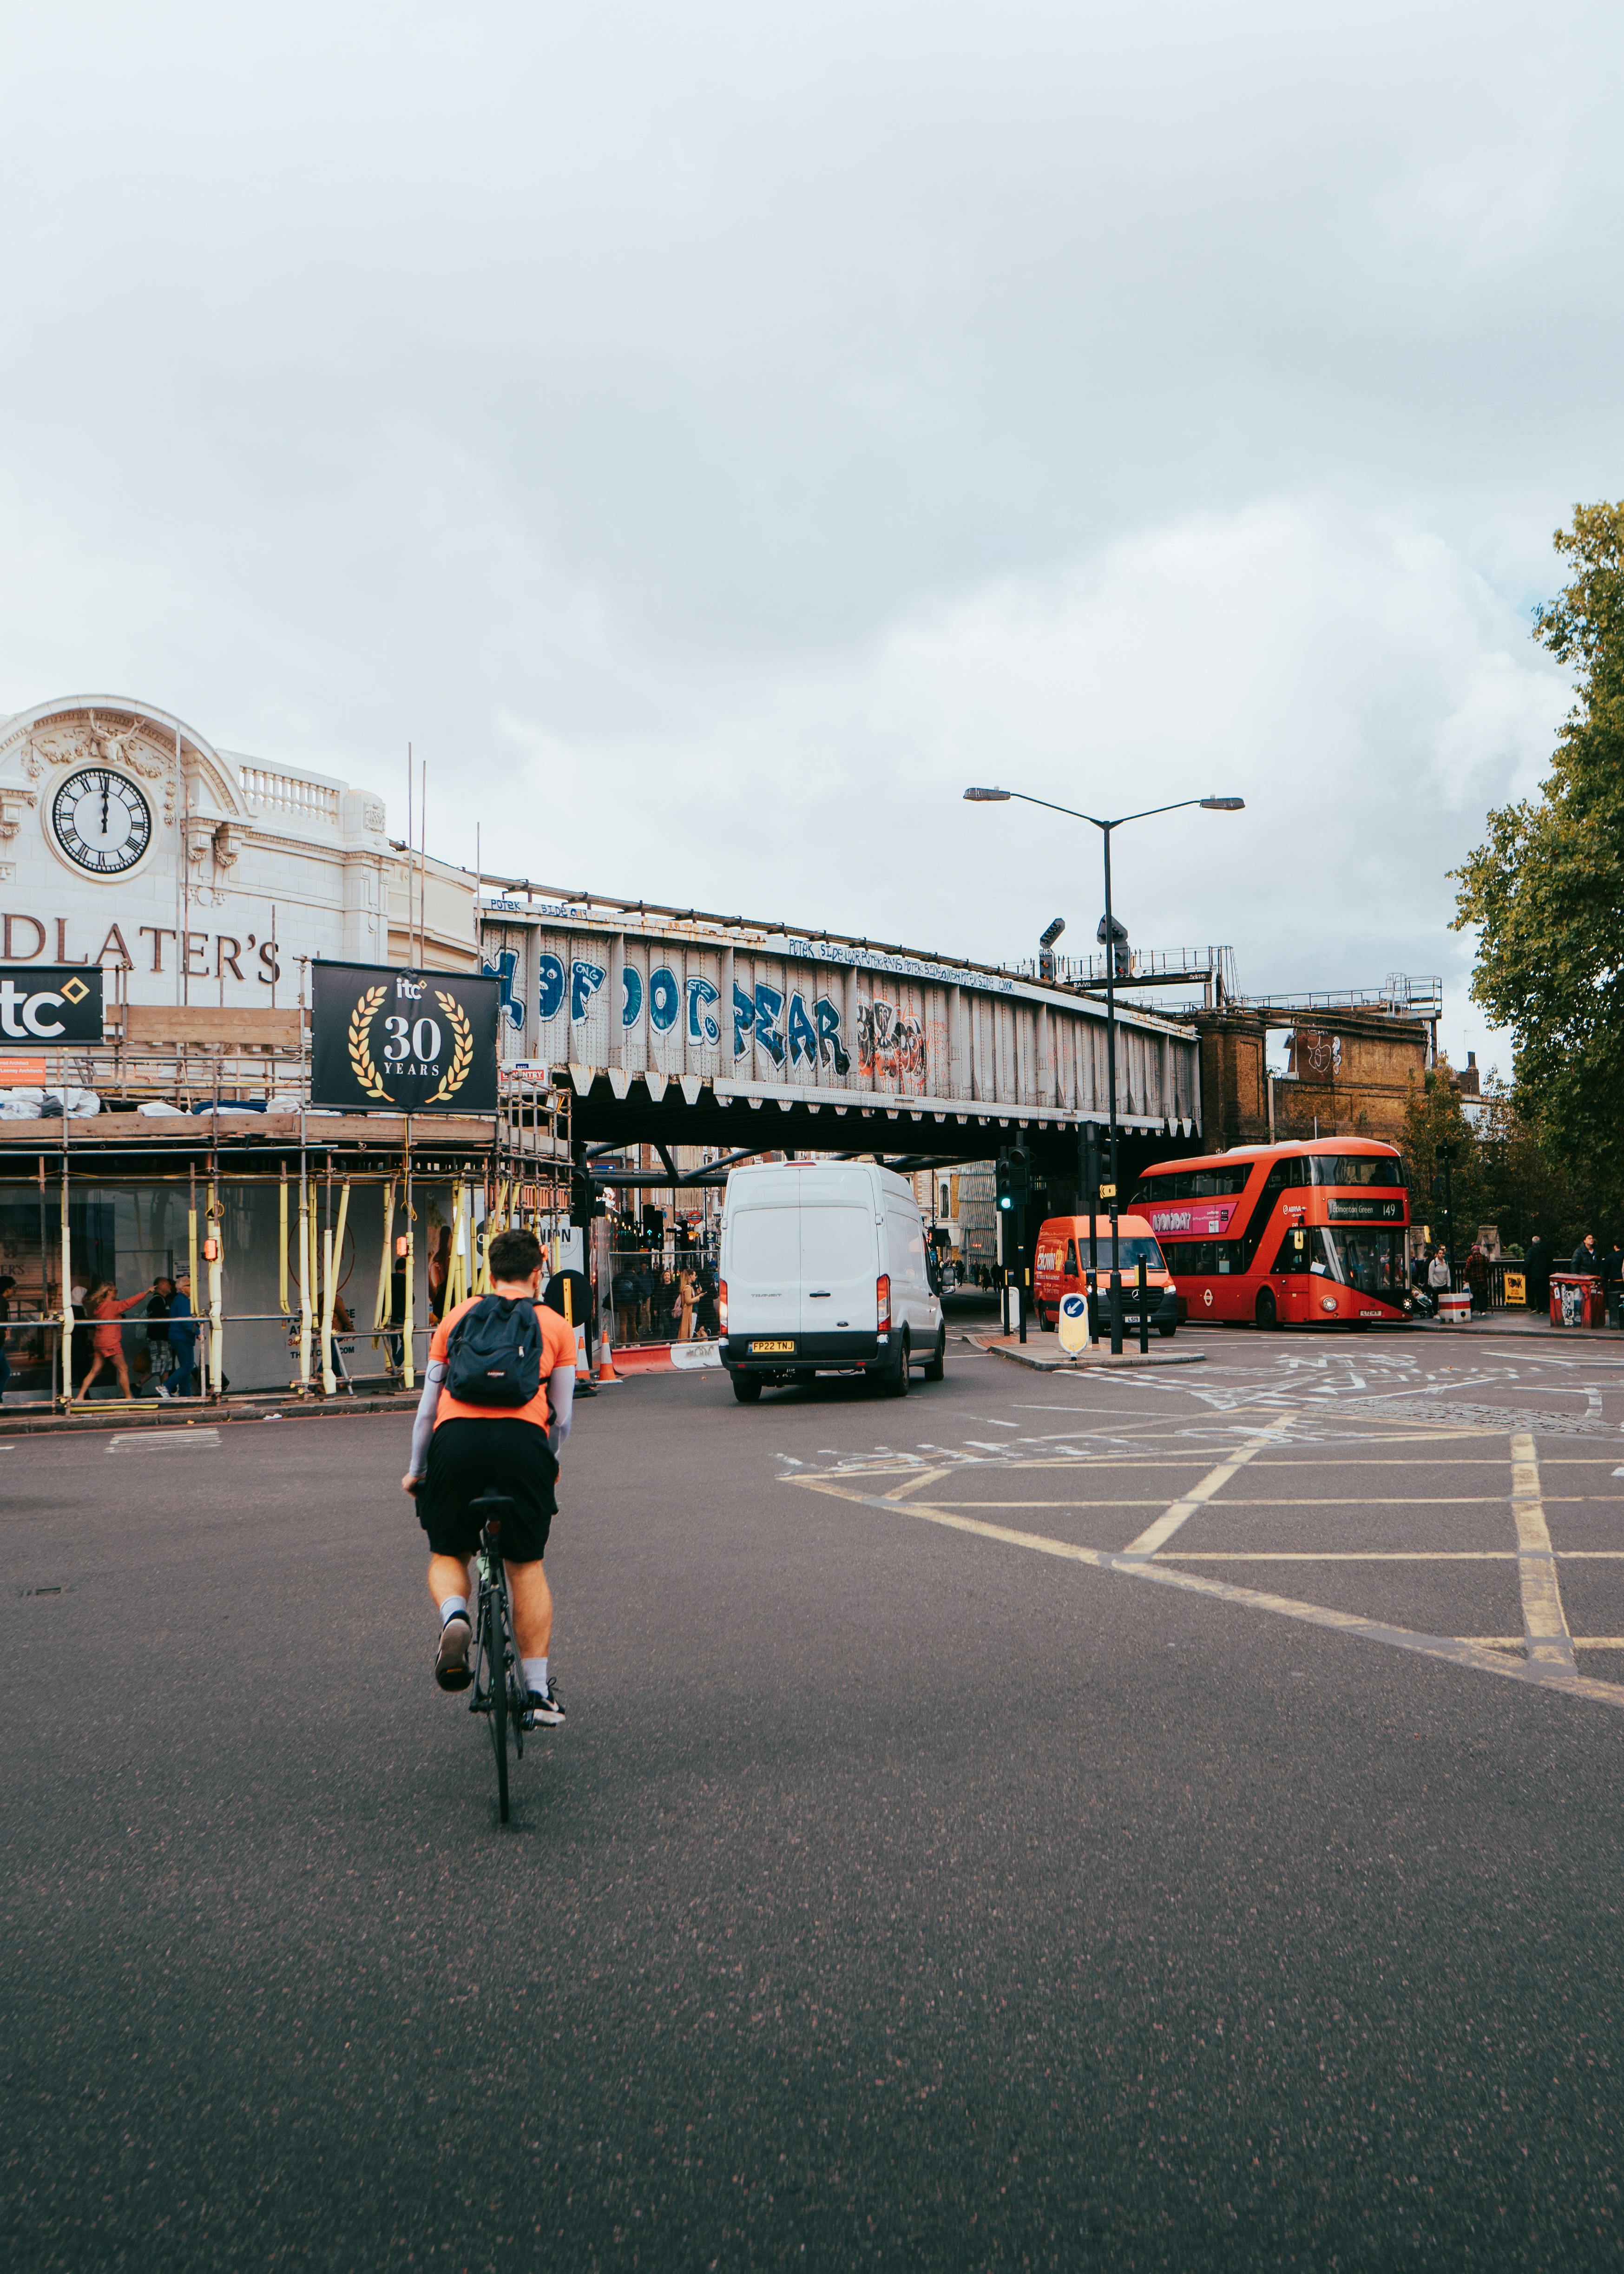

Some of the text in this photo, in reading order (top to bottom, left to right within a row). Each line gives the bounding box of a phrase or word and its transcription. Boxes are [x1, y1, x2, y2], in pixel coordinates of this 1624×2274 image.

[0, 913, 280, 984] DLATER'S
[396, 977, 422, 1000] itc
[384, 1016, 441, 1062] 30
[384, 1062, 439, 1076] YEARS
[1332, 1205, 1357, 1213] Edmonton
[1383, 1204, 1395, 1216] 149
[1037, 1252, 1056, 1271] CROWN
[777, 1341, 793, 1350] TNJ
